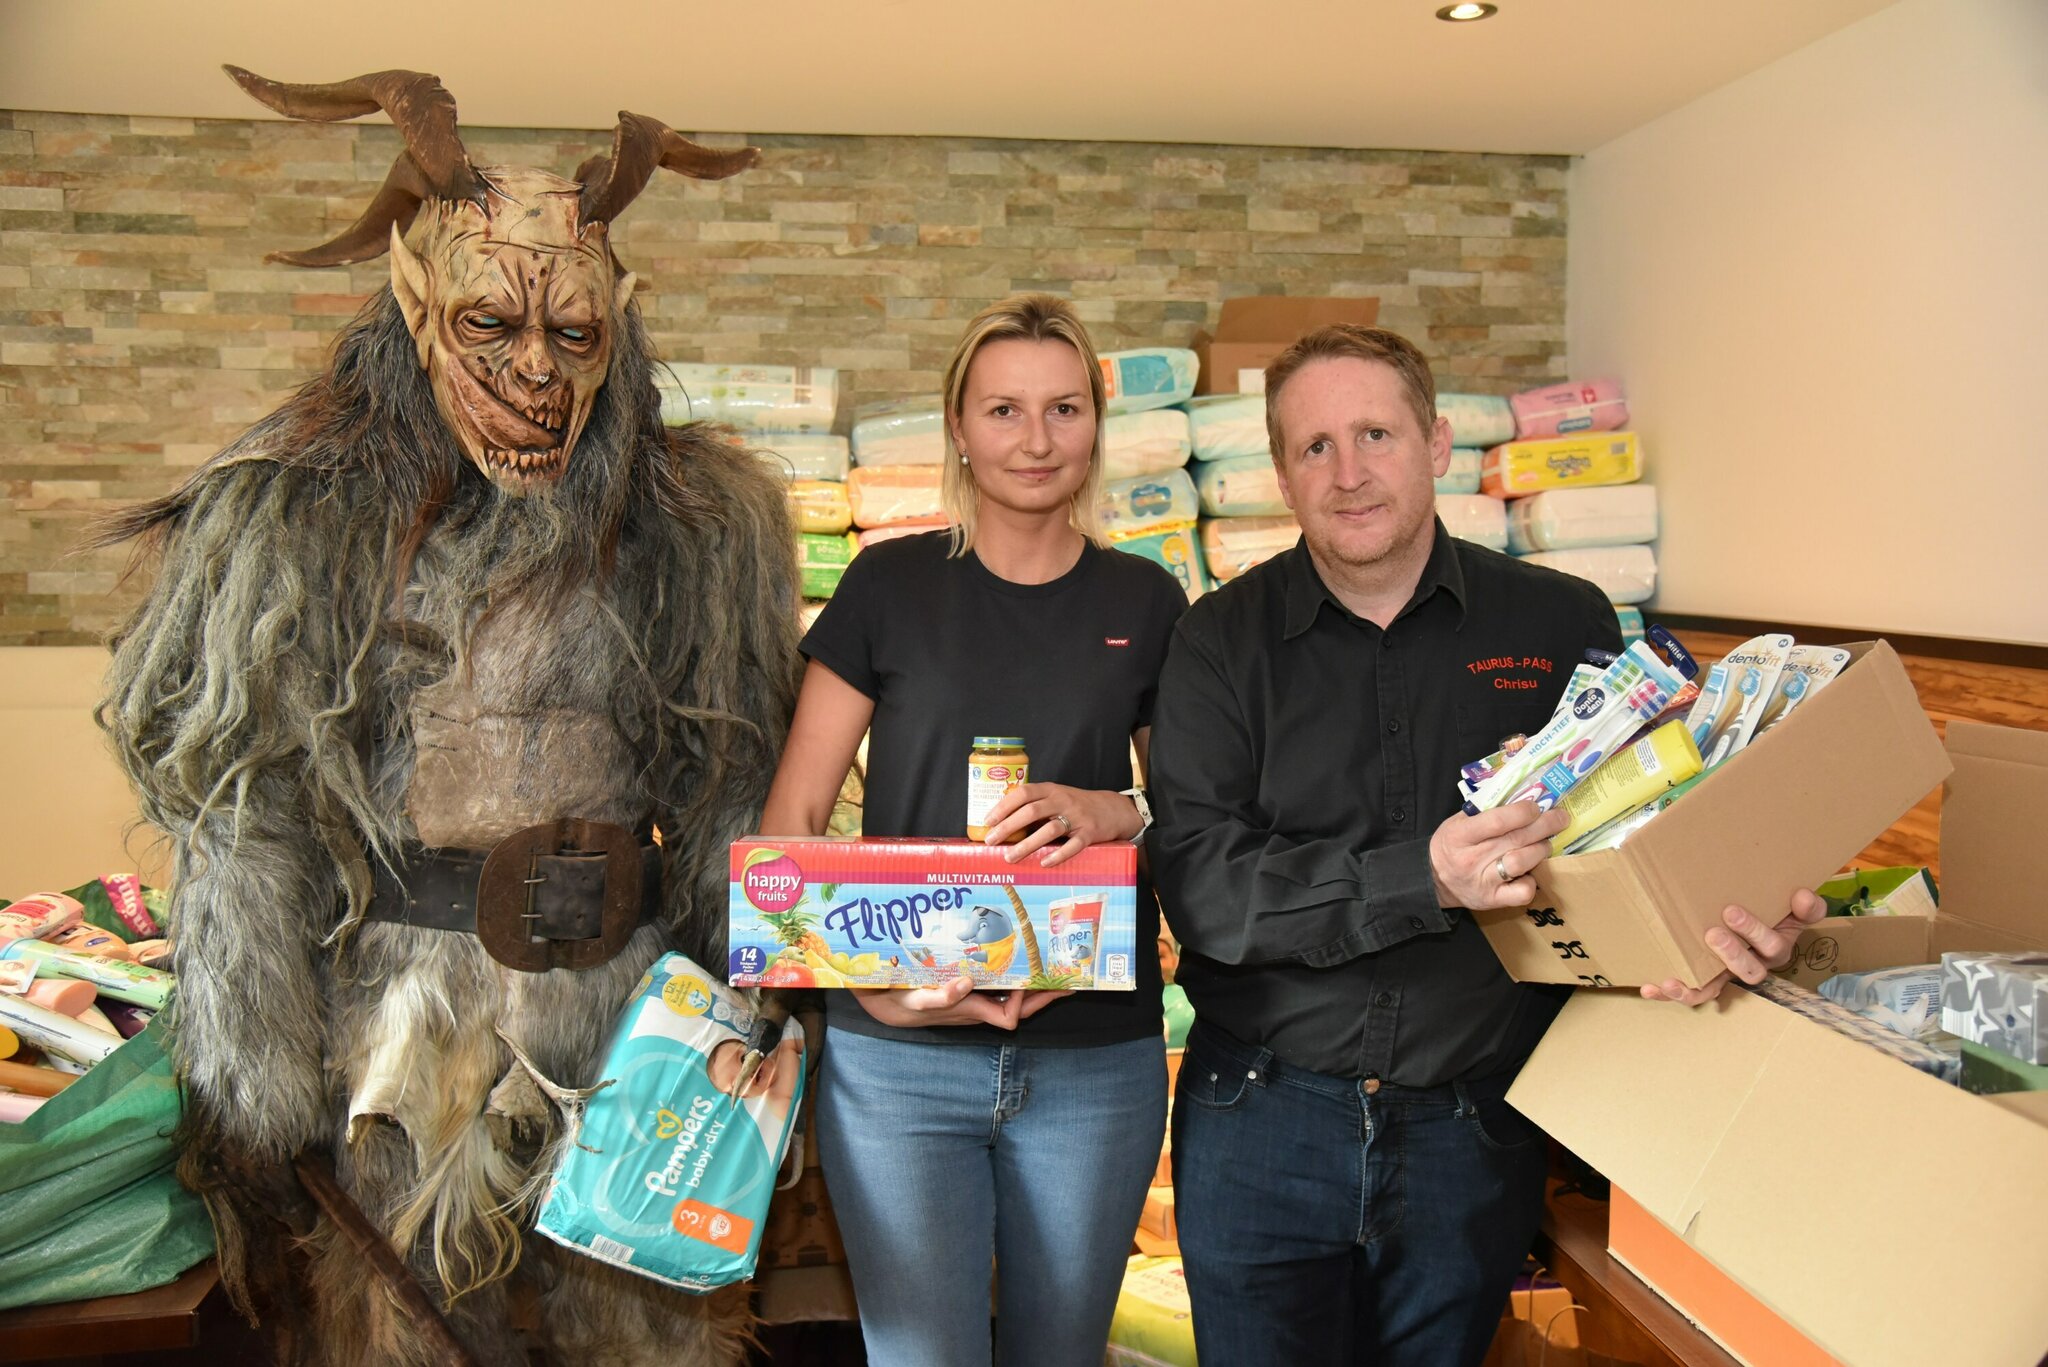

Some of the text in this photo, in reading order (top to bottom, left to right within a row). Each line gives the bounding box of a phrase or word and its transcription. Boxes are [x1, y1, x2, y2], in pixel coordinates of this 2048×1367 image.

[1665, 640, 1686, 661] Mittel
[1494, 678, 1538, 689] Chrisu
[1574, 693, 1598, 715] Donto
[1586, 696, 1605, 714] dent
[1528, 715, 1571, 755] HOCH-TIEF
[1546, 771, 1565, 790] PACK
[747, 872, 802, 891] happy
[927, 873, 1015, 884] MULTIVITAMIN
[757, 891, 788, 902] fruits
[824, 887, 972, 949] Flipper
[740, 948, 757, 962] 14
[645, 1095, 713, 1196] Pampers
[685, 1120, 726, 1188] baby-dry
[680, 1209, 699, 1225] 3
